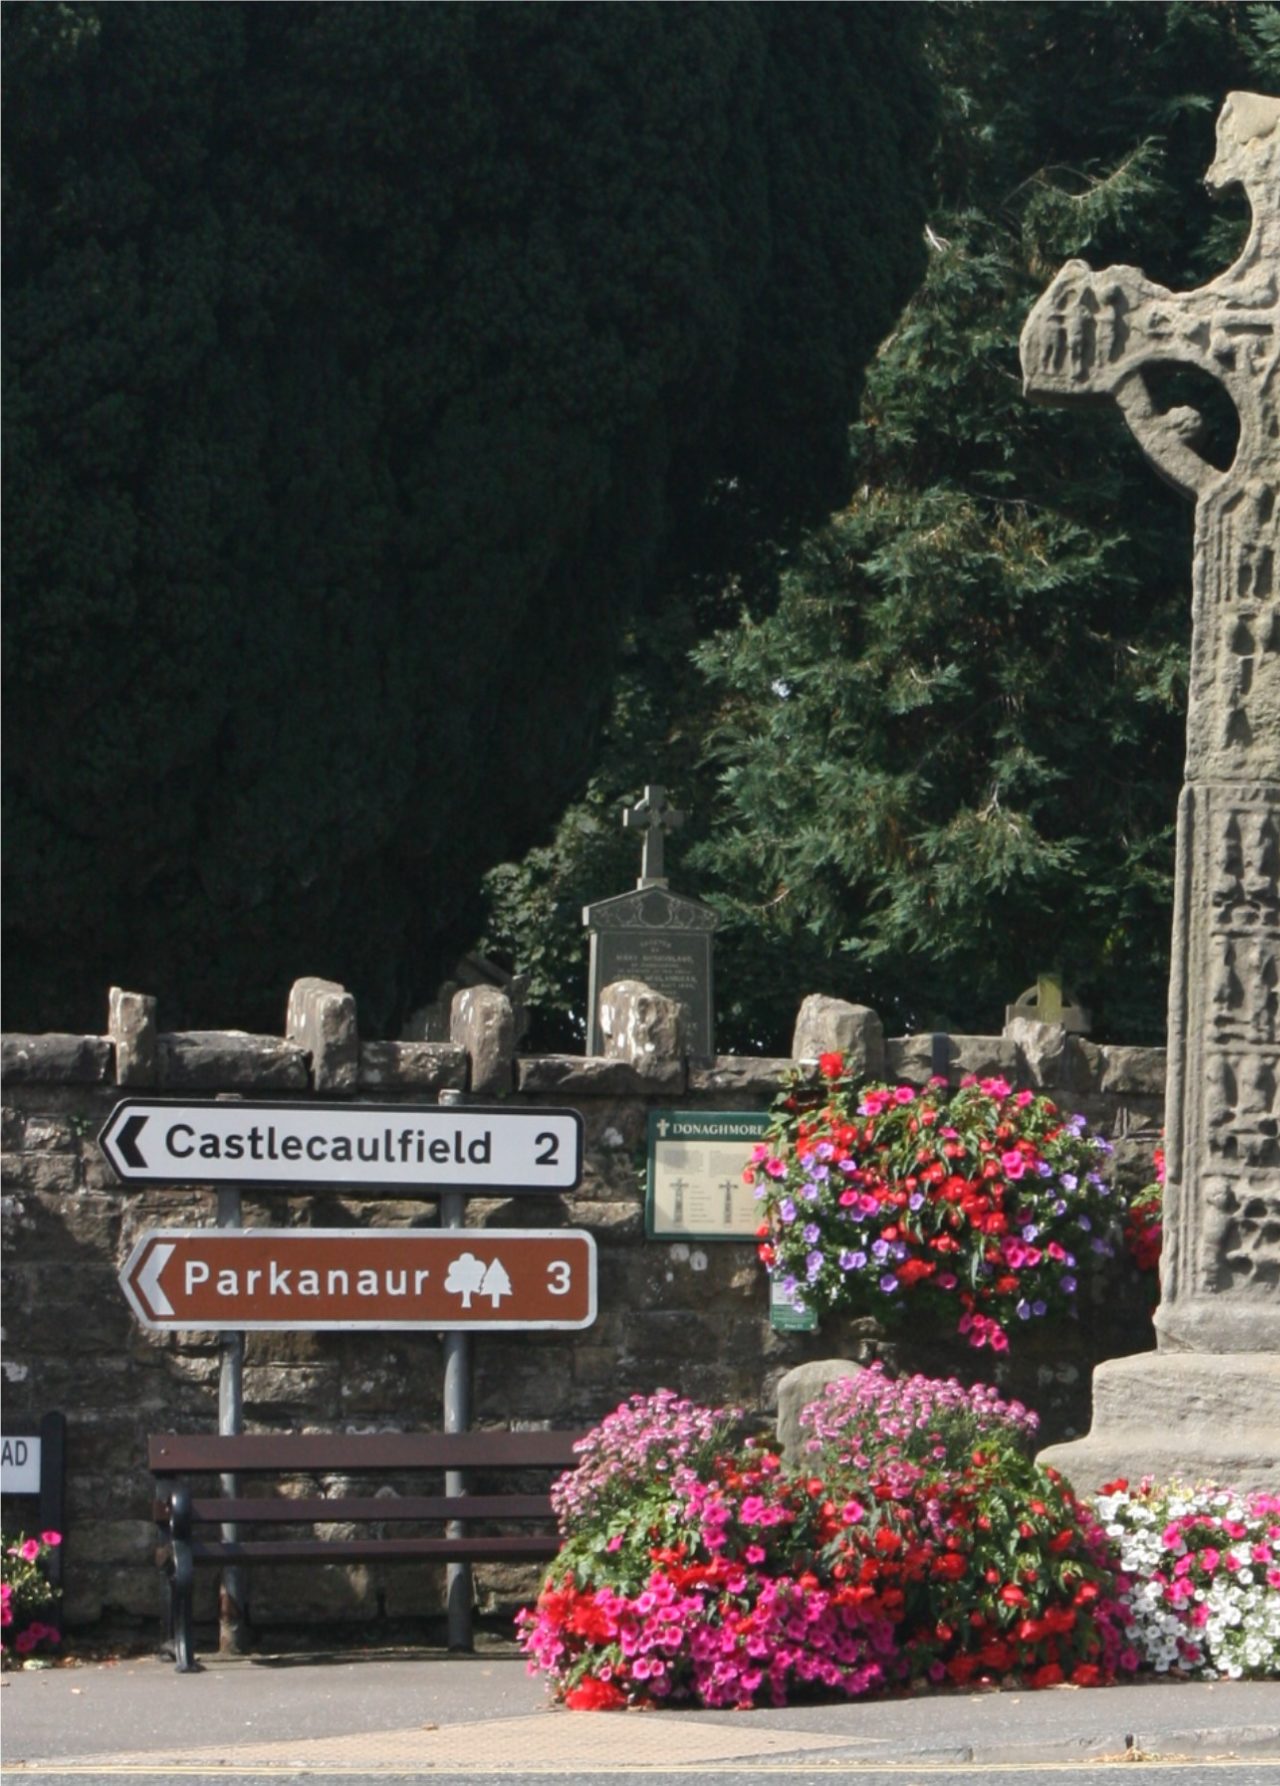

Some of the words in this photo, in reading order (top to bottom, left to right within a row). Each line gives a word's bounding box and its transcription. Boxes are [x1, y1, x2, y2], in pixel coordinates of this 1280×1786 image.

[164, 1123, 493, 1164] Castlecaulfield
[534, 1131, 560, 1166] 2
[672, 1123, 763, 1136] DONAGHMORE
[184, 1260, 430, 1296] Parkanaur
[546, 1260, 571, 1295] 3
[1, 1439, 29, 1467] AD
